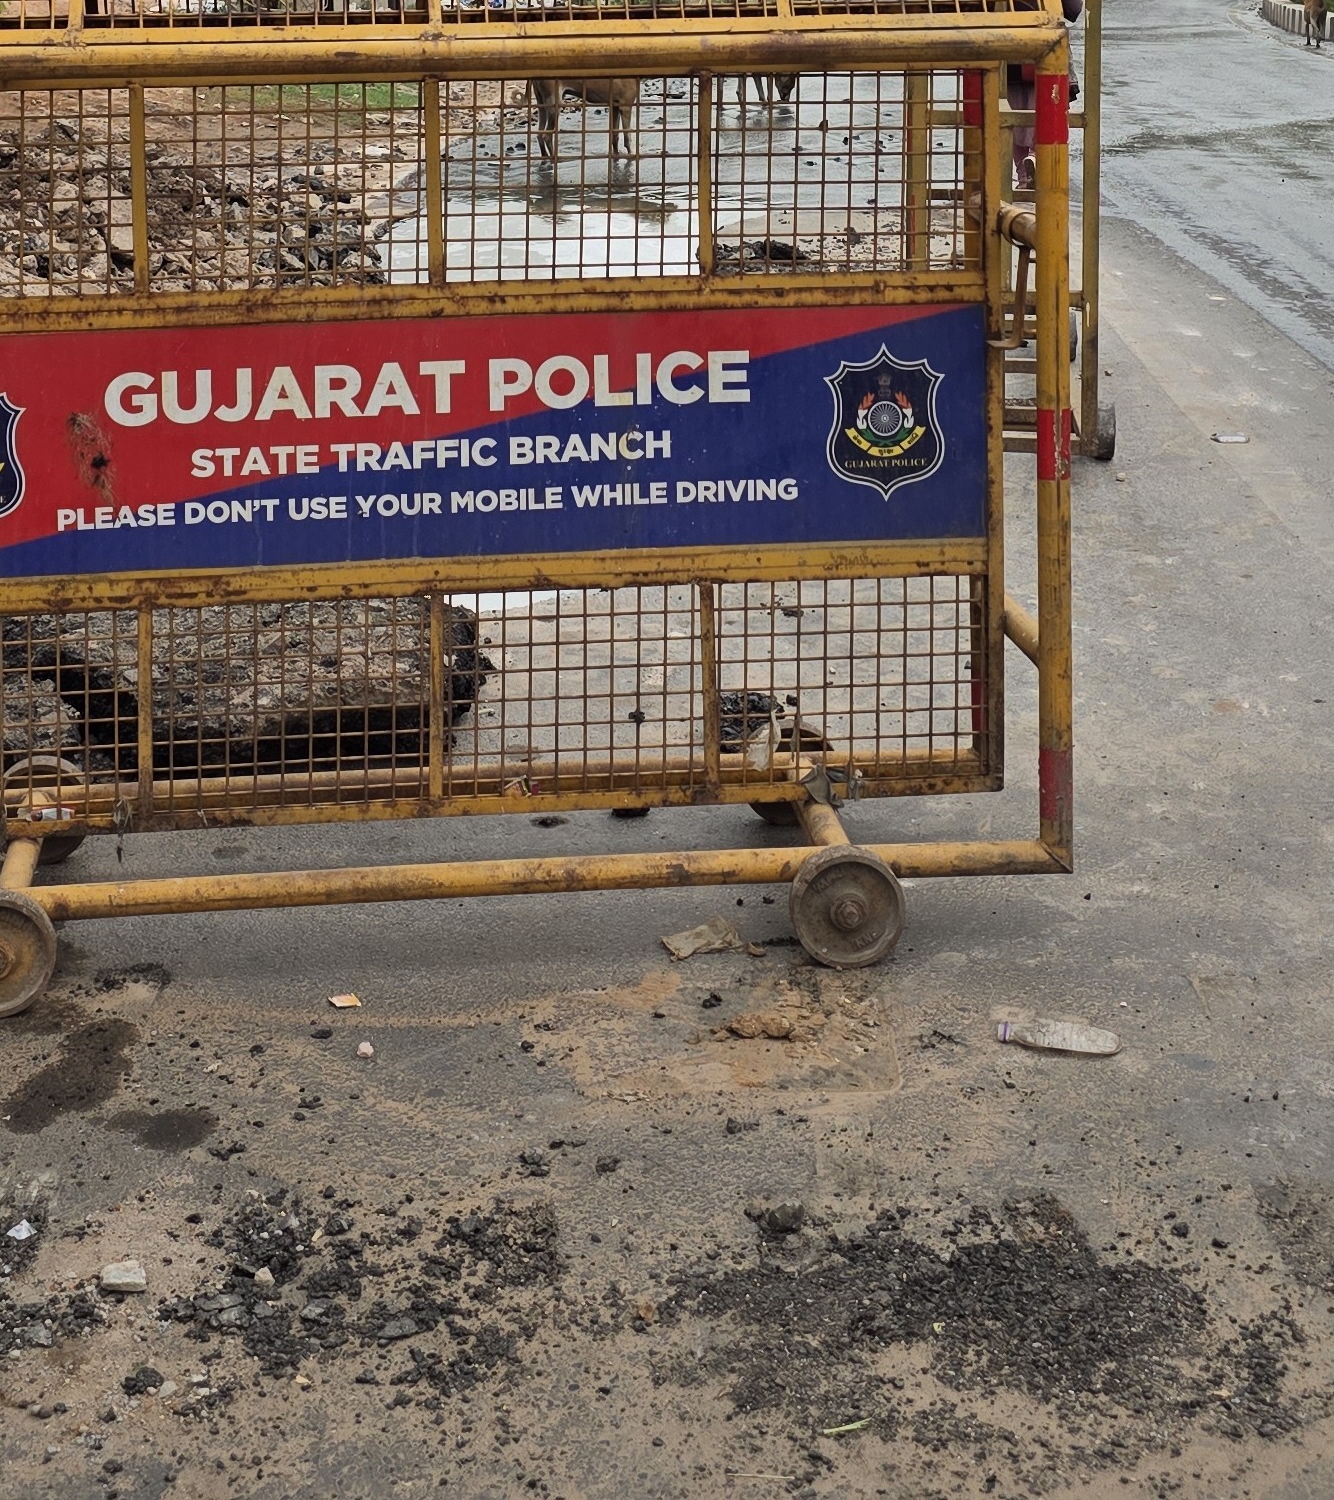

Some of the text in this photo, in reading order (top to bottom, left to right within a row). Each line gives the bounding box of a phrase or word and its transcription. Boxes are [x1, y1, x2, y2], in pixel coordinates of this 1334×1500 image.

[104, 349, 751, 428] GUJARAT POLICE
[190, 429, 673, 478] STATE TRAFFIC BRANCH
[844, 457, 928, 469] GUJARAT POLICE
[57, 477, 799, 532] PLEASE DON'T USE YOUR MOBILE WHILE DRIVING
